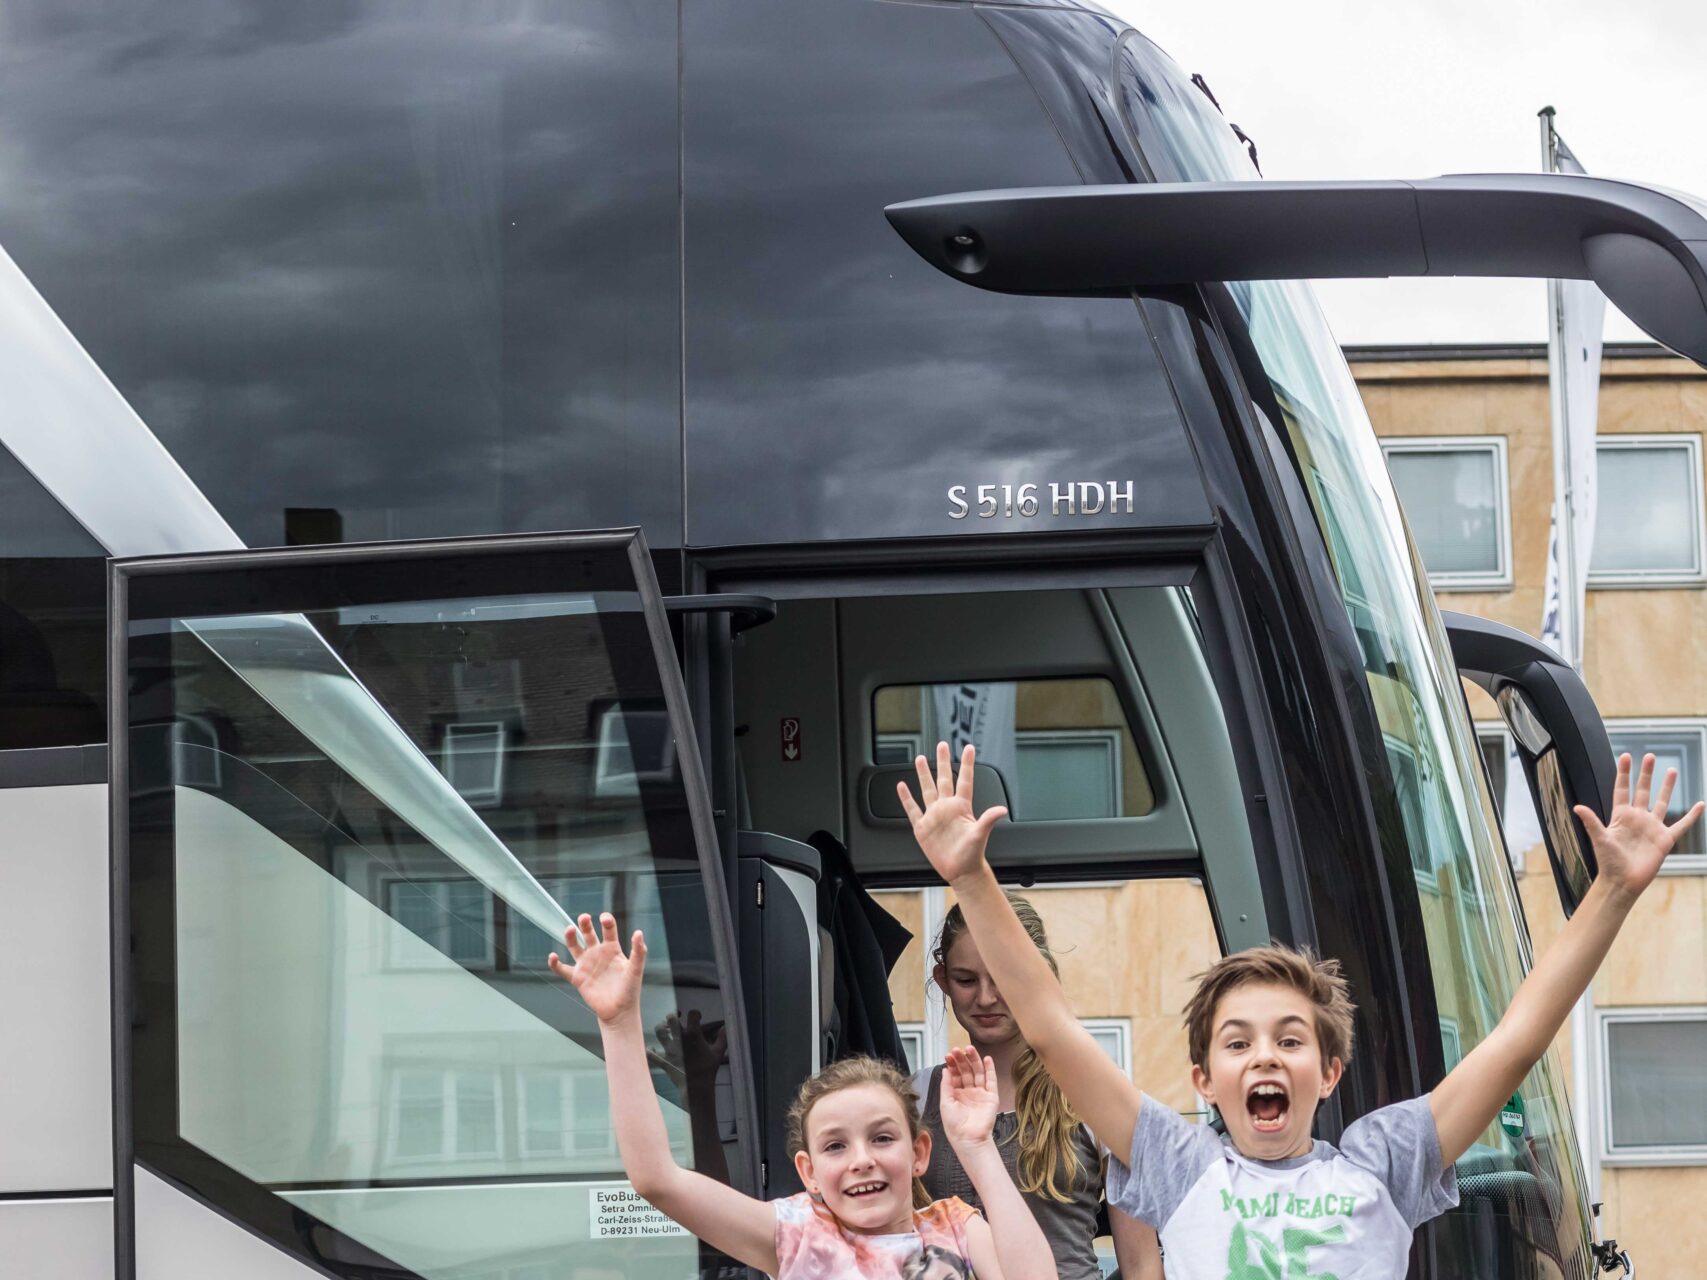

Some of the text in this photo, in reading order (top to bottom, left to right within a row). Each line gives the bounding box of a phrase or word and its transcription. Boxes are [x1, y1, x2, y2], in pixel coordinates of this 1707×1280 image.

[948, 480, 1134, 519] S 516 HDH
[597, 1191, 641, 1202] EvoBus
[601, 1205, 625, 1213] Setra
[601, 1225, 680, 1235] D-89231 Neu-Ulm
